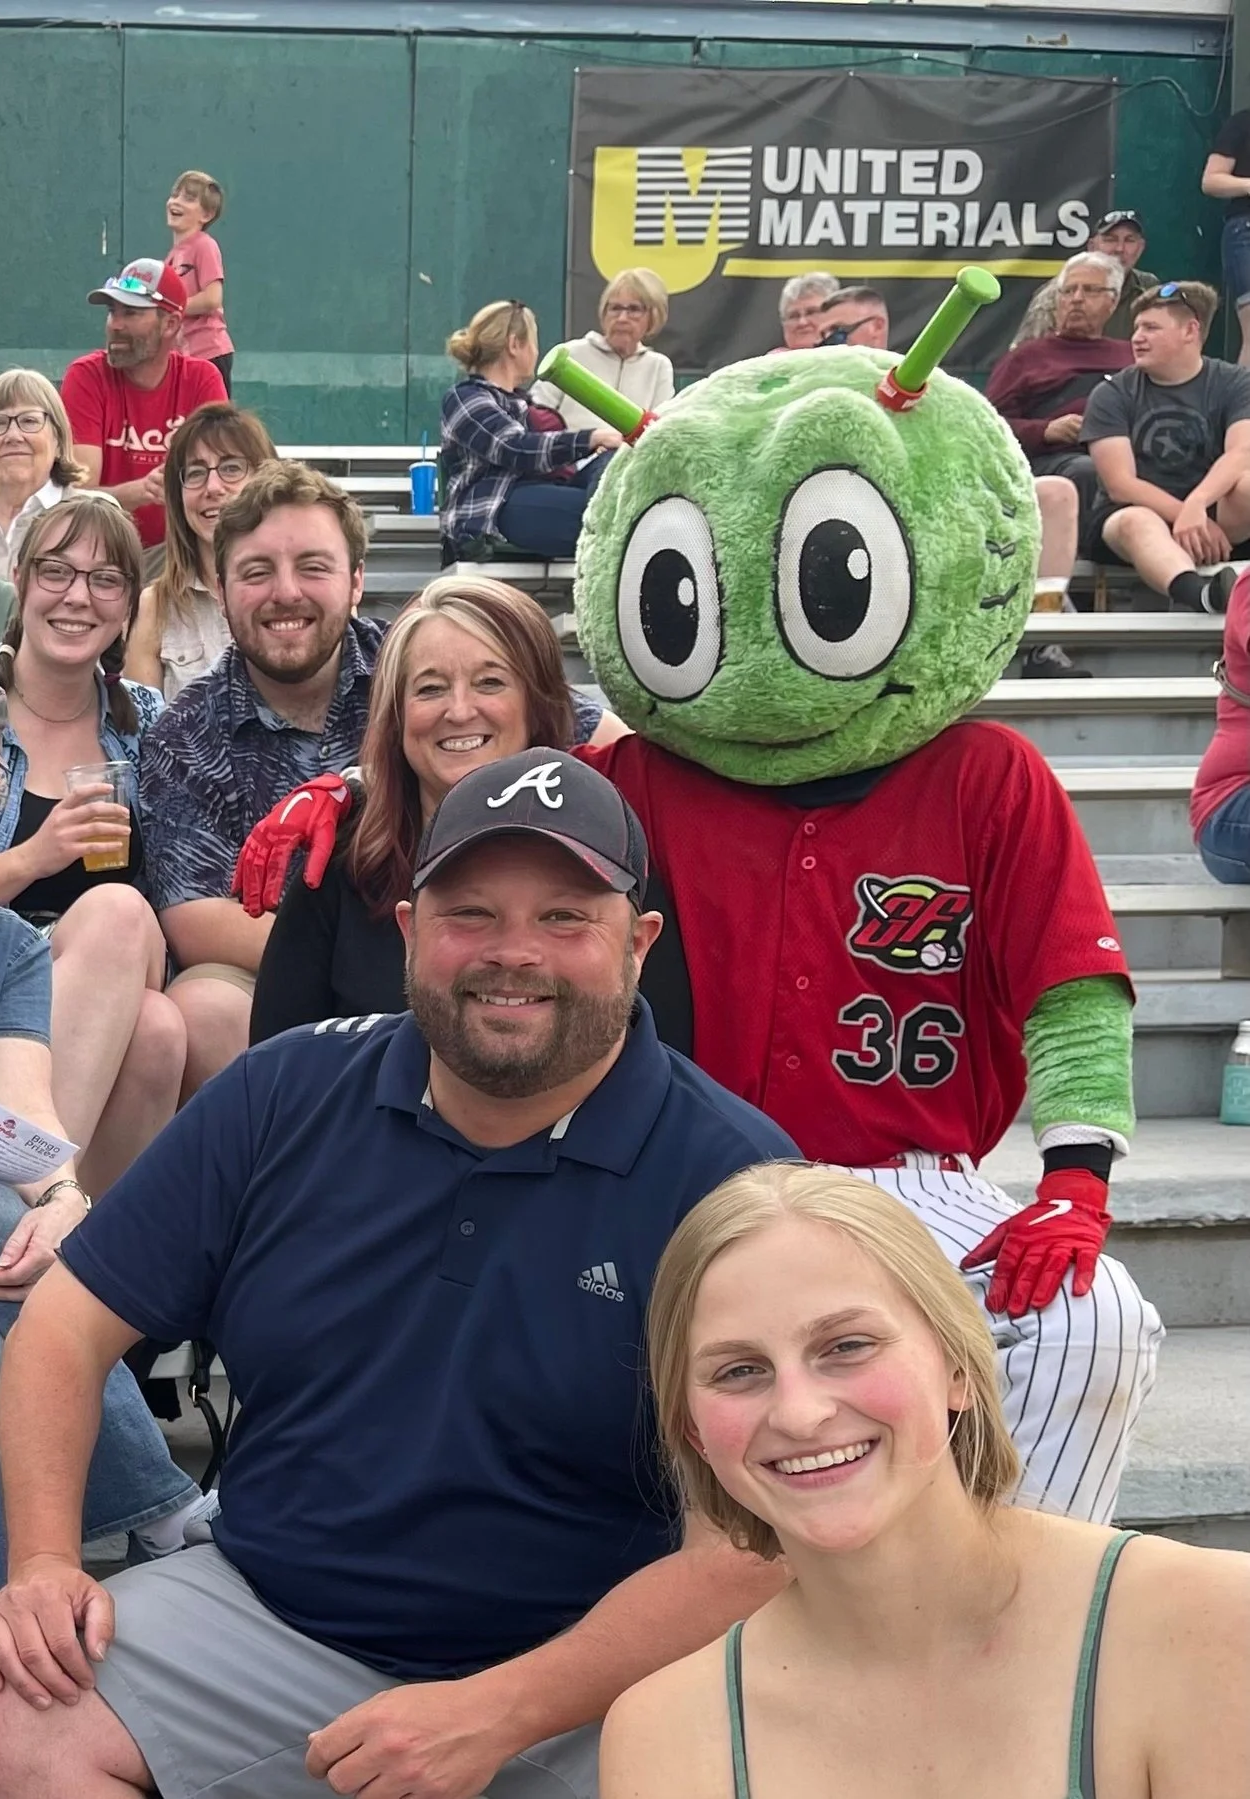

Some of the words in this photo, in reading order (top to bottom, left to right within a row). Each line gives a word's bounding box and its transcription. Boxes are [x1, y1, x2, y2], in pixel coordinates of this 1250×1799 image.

[762, 145, 983, 195] UNITED
[758, 199, 1090, 248] MATERIALS
[487, 761, 563, 809] A
[832, 993, 965, 1089] 36
[24, 1140, 56, 1159] Prizes
[31, 1134, 60, 1153] Bingo
